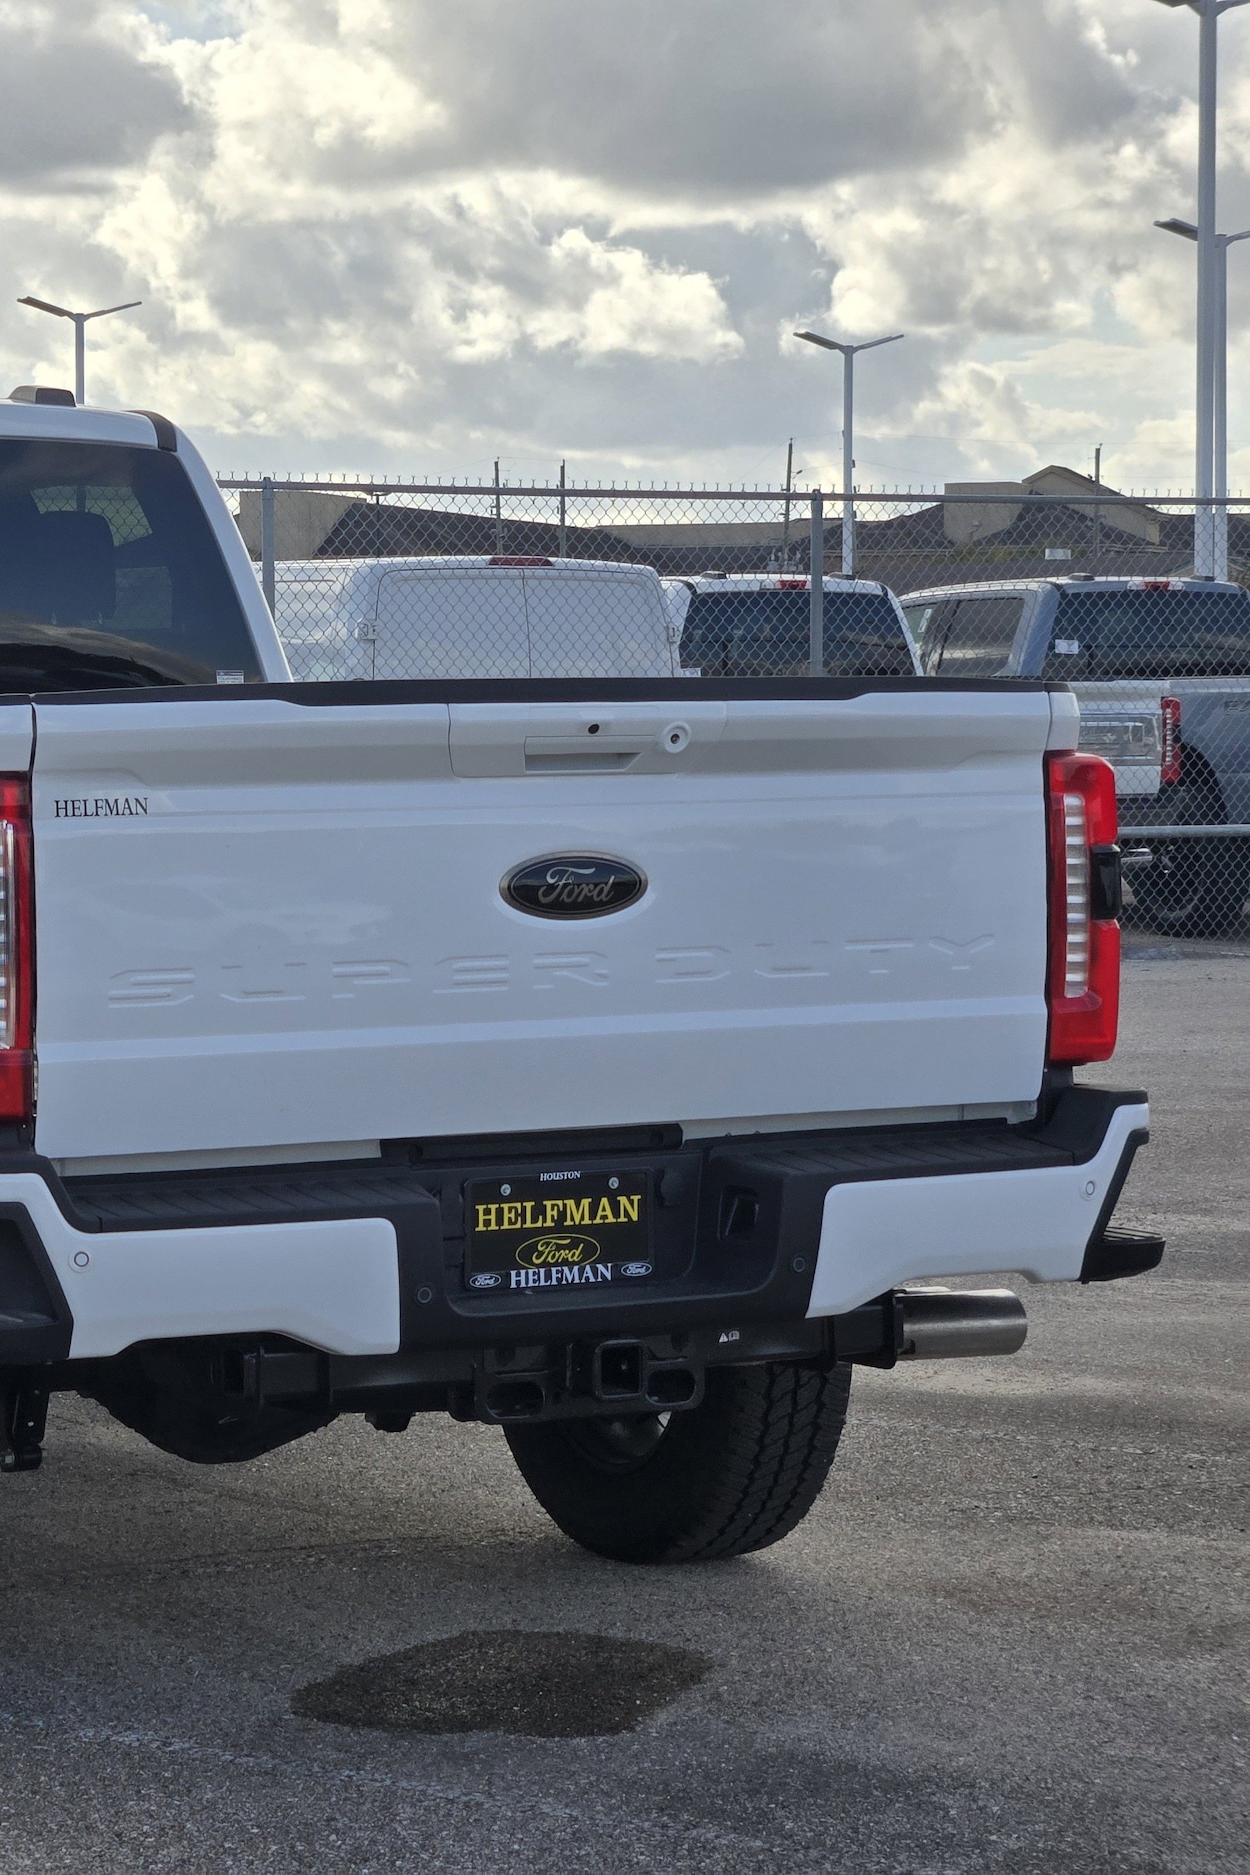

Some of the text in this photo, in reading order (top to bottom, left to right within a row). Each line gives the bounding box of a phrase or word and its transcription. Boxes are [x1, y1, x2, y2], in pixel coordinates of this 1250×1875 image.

[54, 797, 148, 818] HELFMAN
[538, 866, 616, 904] Ford
[108, 933, 995, 1008] SUPER DUTY
[539, 1171, 581, 1182] HOUSTON
[474, 1195, 642, 1232] HELFMAN
[531, 1239, 584, 1265] Ford
[509, 1263, 613, 1289] HELFMAN
